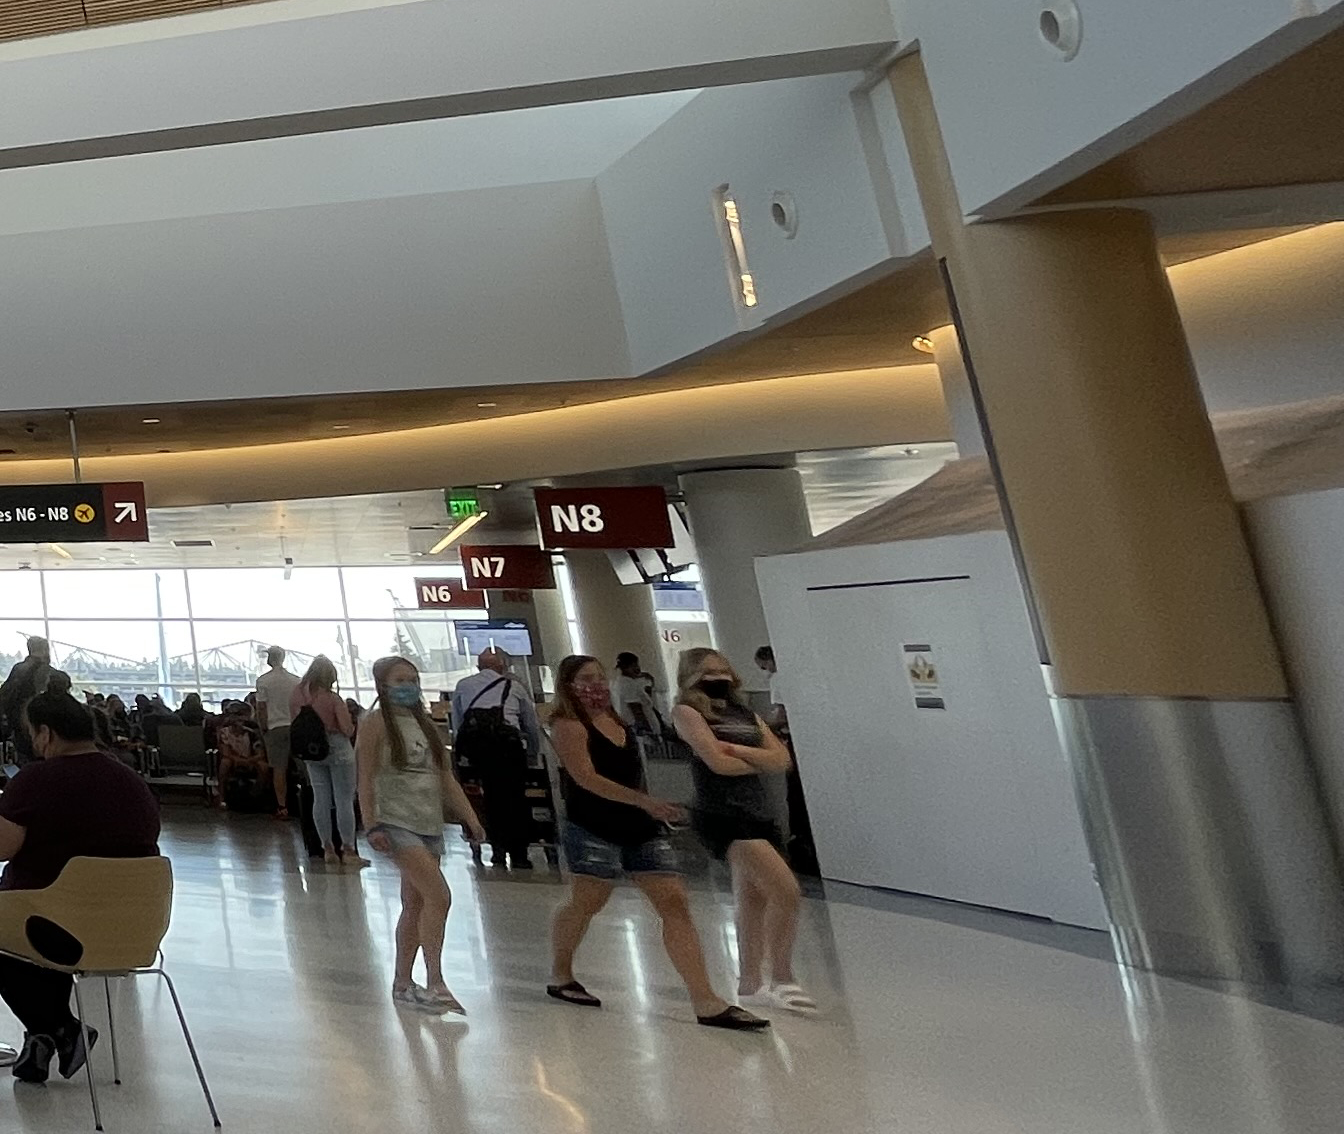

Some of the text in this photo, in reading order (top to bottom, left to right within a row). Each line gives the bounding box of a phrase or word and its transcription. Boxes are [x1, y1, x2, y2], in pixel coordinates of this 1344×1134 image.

[15, 507, 36, 522] N6
[48, 507, 69, 521] N8
[452, 500, 477, 517] EXIT
[550, 504, 604, 533] N8
[470, 557, 505, 578] N7
[421, 585, 451, 603] N6
